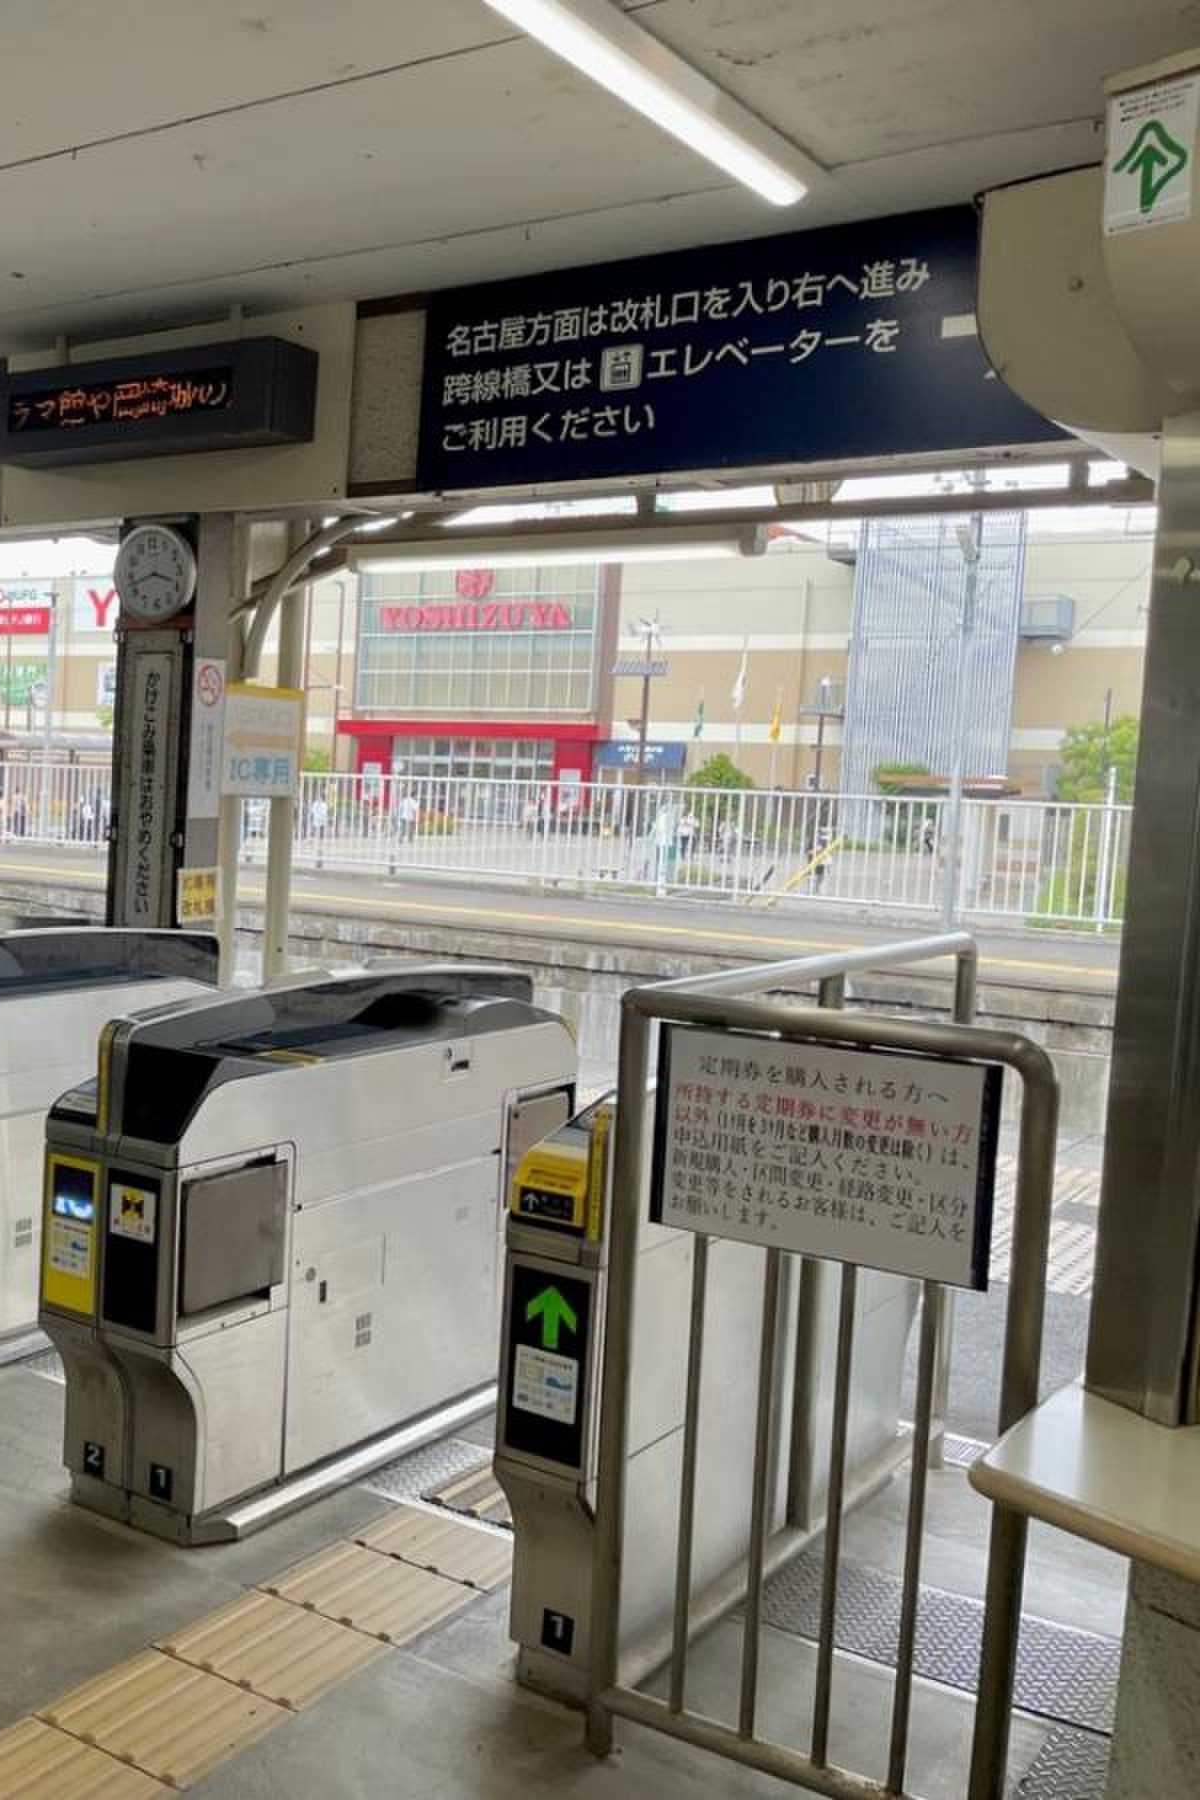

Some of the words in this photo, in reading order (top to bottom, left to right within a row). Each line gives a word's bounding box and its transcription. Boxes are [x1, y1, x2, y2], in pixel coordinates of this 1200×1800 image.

[446, 257, 930, 358] 名古屋方面は改札口を入り右へ進み
[442, 357, 592, 407] 跨線橋又は
[646, 318, 900, 381] エレベーターを
[442, 403, 655, 453] ご利用ください
[86, 588, 116, 628] Y
[378, 602, 571, 630] YOSHIZUYA
[135, 671, 161, 914] かけこみ乗車はおやめください
[229, 757, 291, 785] IC専用
[699, 1054, 949, 1105] 定期券を購入される方へ
[674, 1081, 975, 1145] 所持する定期券に変更が無い方
[673, 1126, 922, 1186] 申込用紙をご記入ください。
[87, 1445, 100, 1464] 2
